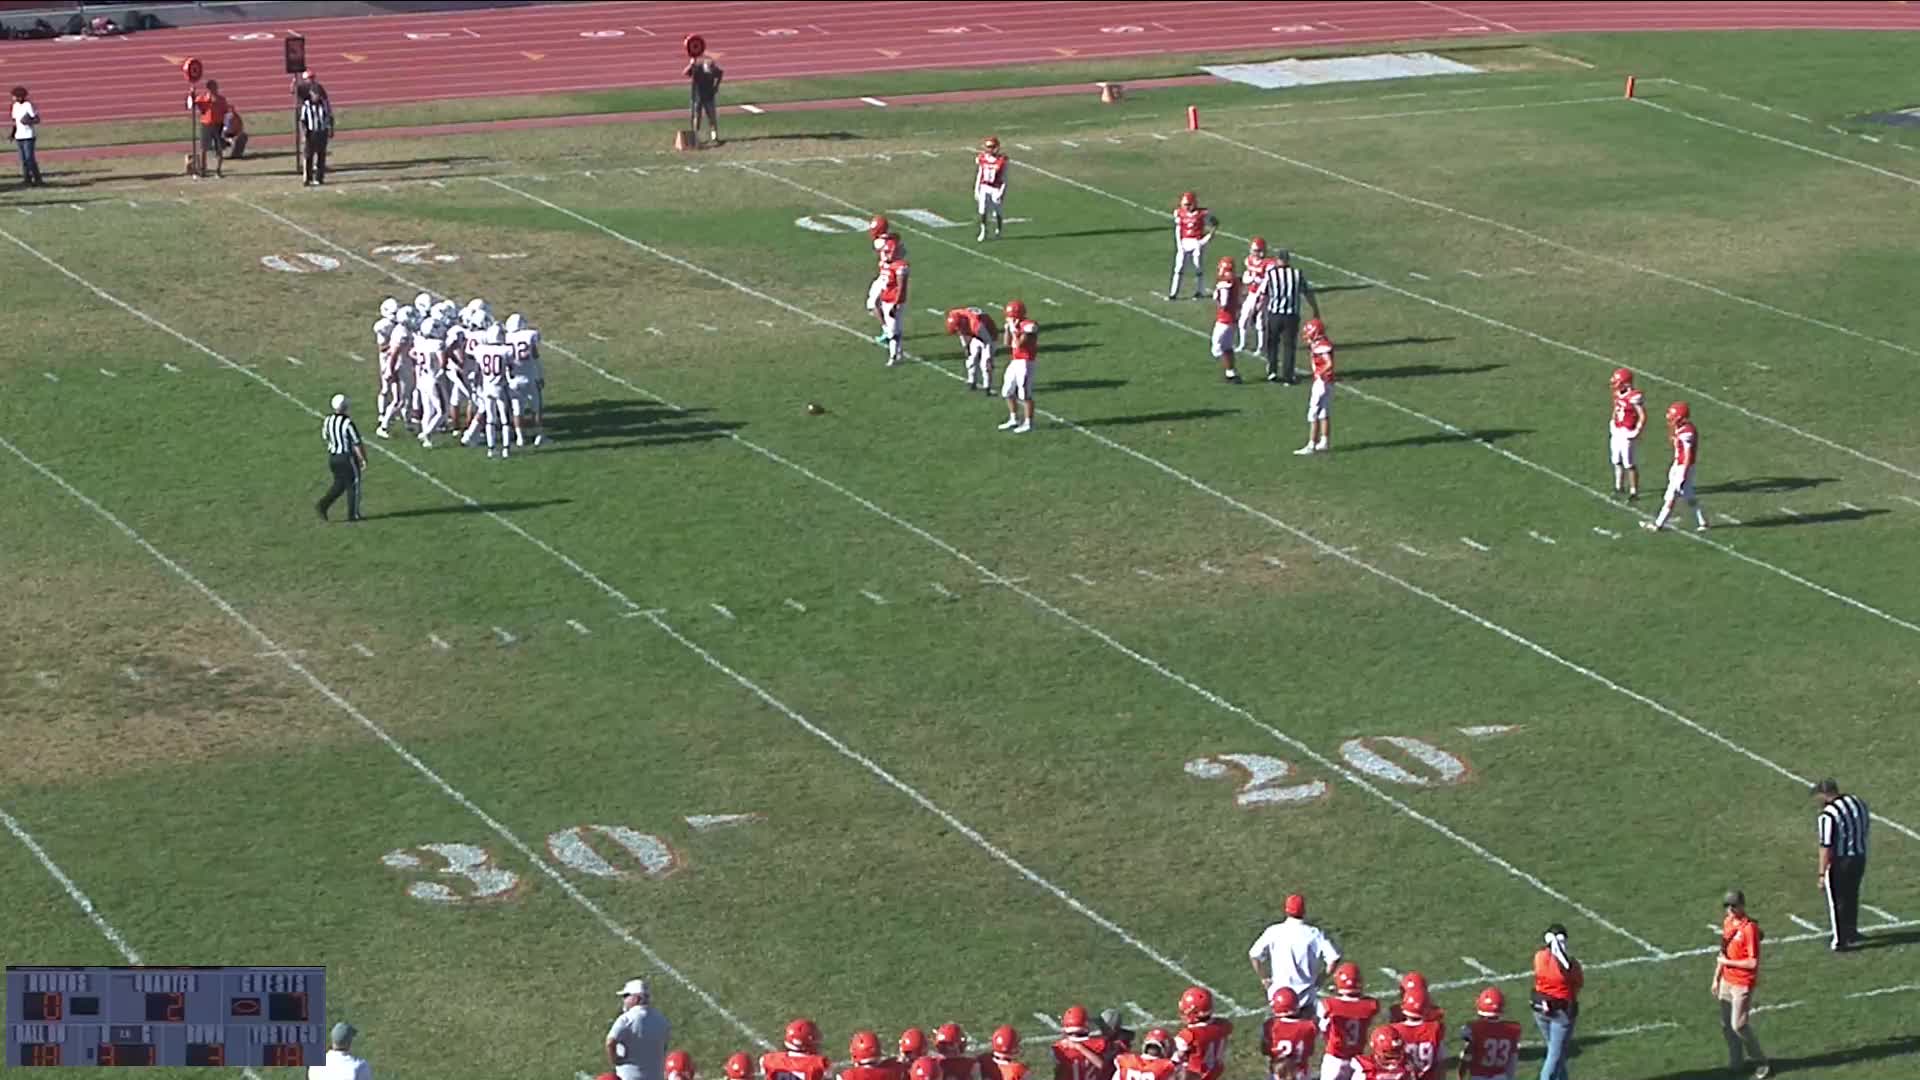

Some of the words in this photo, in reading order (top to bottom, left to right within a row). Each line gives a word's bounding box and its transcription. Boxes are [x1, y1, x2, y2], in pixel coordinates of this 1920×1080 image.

[482, 354, 503, 376] 80
[1183, 734, 1468, 807] 20
[380, 823, 682, 903] 30
